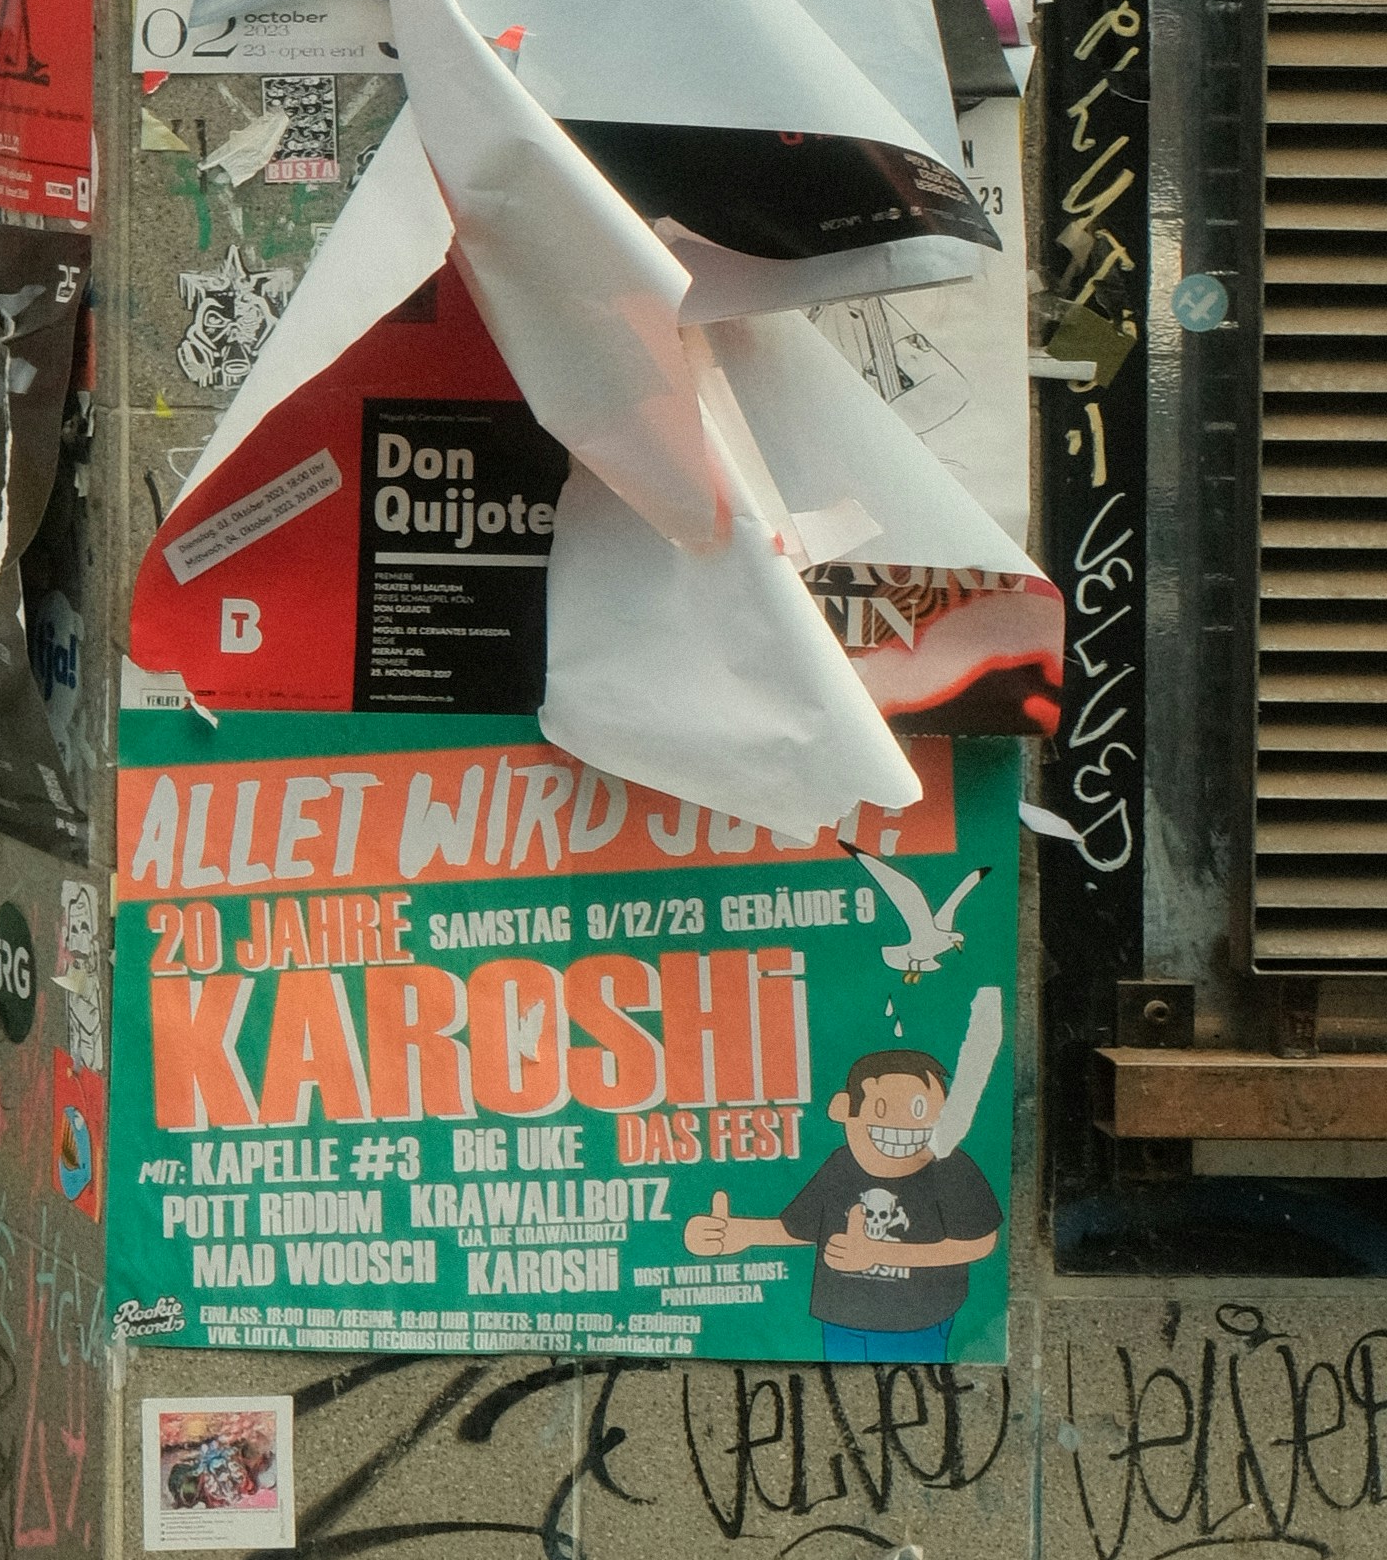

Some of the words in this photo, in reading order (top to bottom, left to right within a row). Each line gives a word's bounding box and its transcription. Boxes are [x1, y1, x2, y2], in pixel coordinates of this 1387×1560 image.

[243, 23, 290, 36] 2023
[244, 11, 328, 23] october
[267, 161, 335, 181] BUSTA
[377, 433, 474, 480] Don
[374, 486, 556, 548] Quijote
[132, 770, 385, 890] ALLET
[399, 756, 628, 880] WIRD
[148, 904, 221, 976] 20
[235, 893, 413, 968] JAHRE
[429, 911, 571, 950] SAMSTAG
[587, 901, 704, 939] 9/12/23
[720, 890, 849, 932] GEBÄUDE
[855, 890, 876, 925] 9
[517, 1126, 584, 1170] UKE
[618, 1113, 695, 1165] DAS
[708, 1108, 802, 1161] FEST
[138, 1159, 187, 1186] MIT:
[191, 1138, 339, 1185] KAPELLE
[349, 1136, 421, 1179] #3
[164, 1195, 249, 1238] POTT
[410, 1179, 671, 1228] KRAWALLBOTZ
[192, 1245, 277, 1288] MAD
[286, 1241, 436, 1284] WOOSCH
[113, 1318, 185, 1340] Records
[114, 1297, 182, 1325] Rookie
